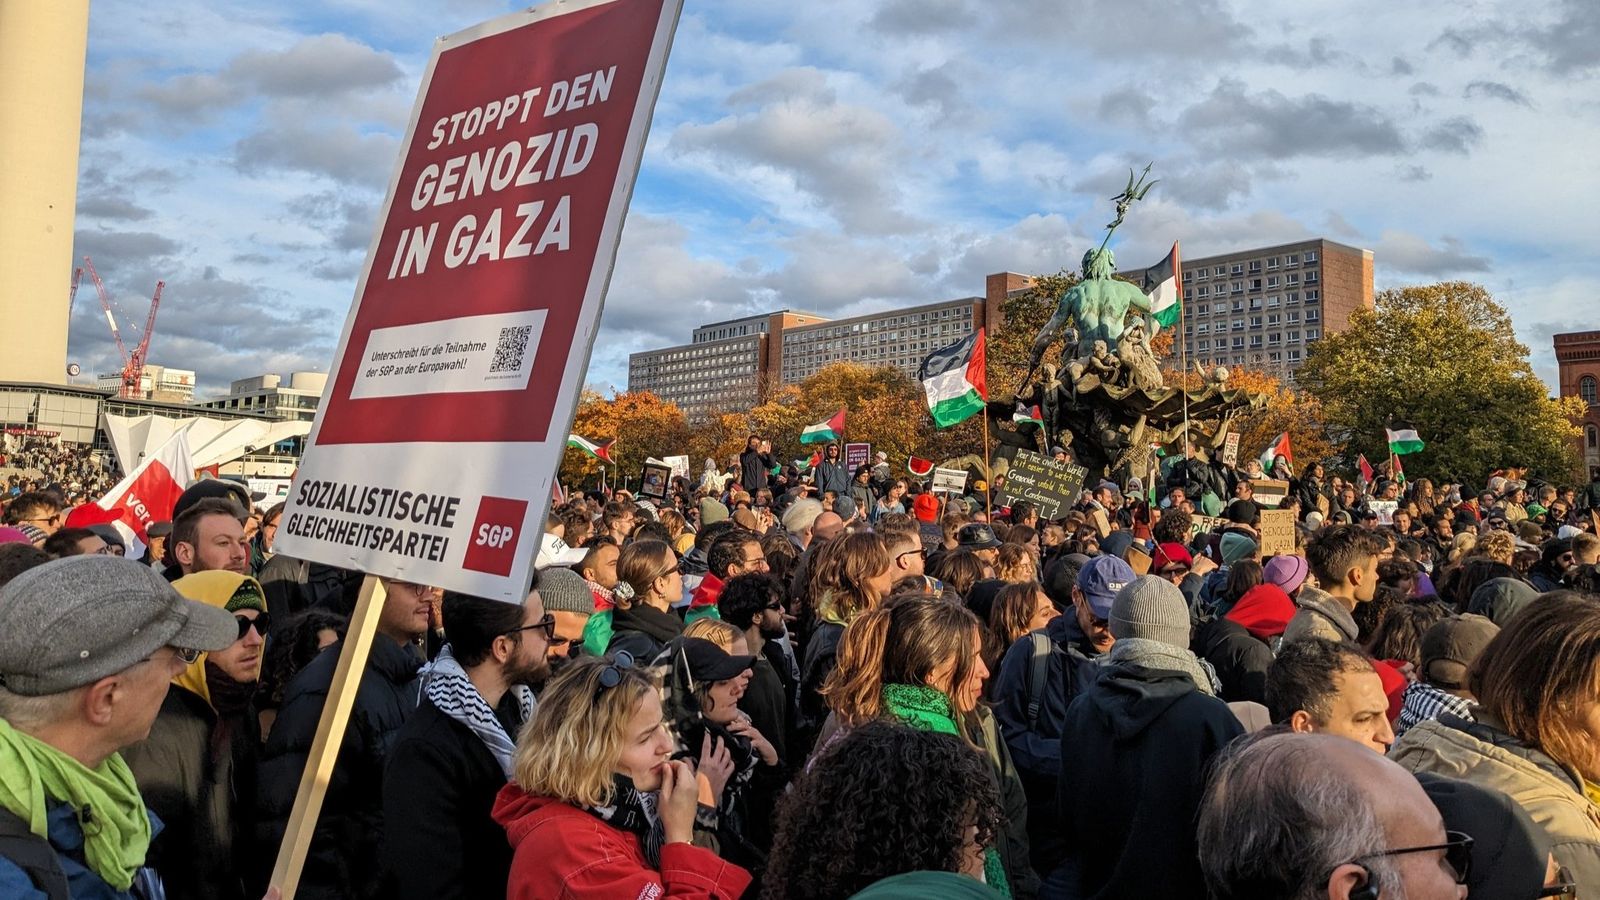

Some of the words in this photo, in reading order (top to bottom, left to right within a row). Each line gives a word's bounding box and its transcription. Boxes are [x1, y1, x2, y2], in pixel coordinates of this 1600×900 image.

[427, 87, 542, 150] STOPPT
[543, 65, 618, 118] DEN
[411, 122, 599, 212] GENOZID
[387, 222, 440, 280] IN
[444, 195, 571, 269] GAZA
[371, 347, 419, 362] Unterschreibt
[420, 345, 431, 357] für
[432, 344, 444, 356] die
[445, 341, 487, 355] Teilnahme
[366, 367, 379, 378] der
[379, 364, 394, 377] SGP
[394, 366, 404, 375] an
[405, 363, 418, 375] der
[418, 358, 467, 374] Europawahl!
[1027, 464, 1045, 474] easier
[1054, 471, 1073, 482] watch
[295, 479, 461, 529] SOZIALISTISCHE
[1263, 512, 1280, 523] STOP
[1281, 511, 1294, 523] THE
[286, 512, 451, 563] GLEICHHEITSPARTEI
[475, 523, 514, 549] SGP
[1262, 526, 1294, 537] GENOCIDE
[1264, 541, 1272, 551] IN
